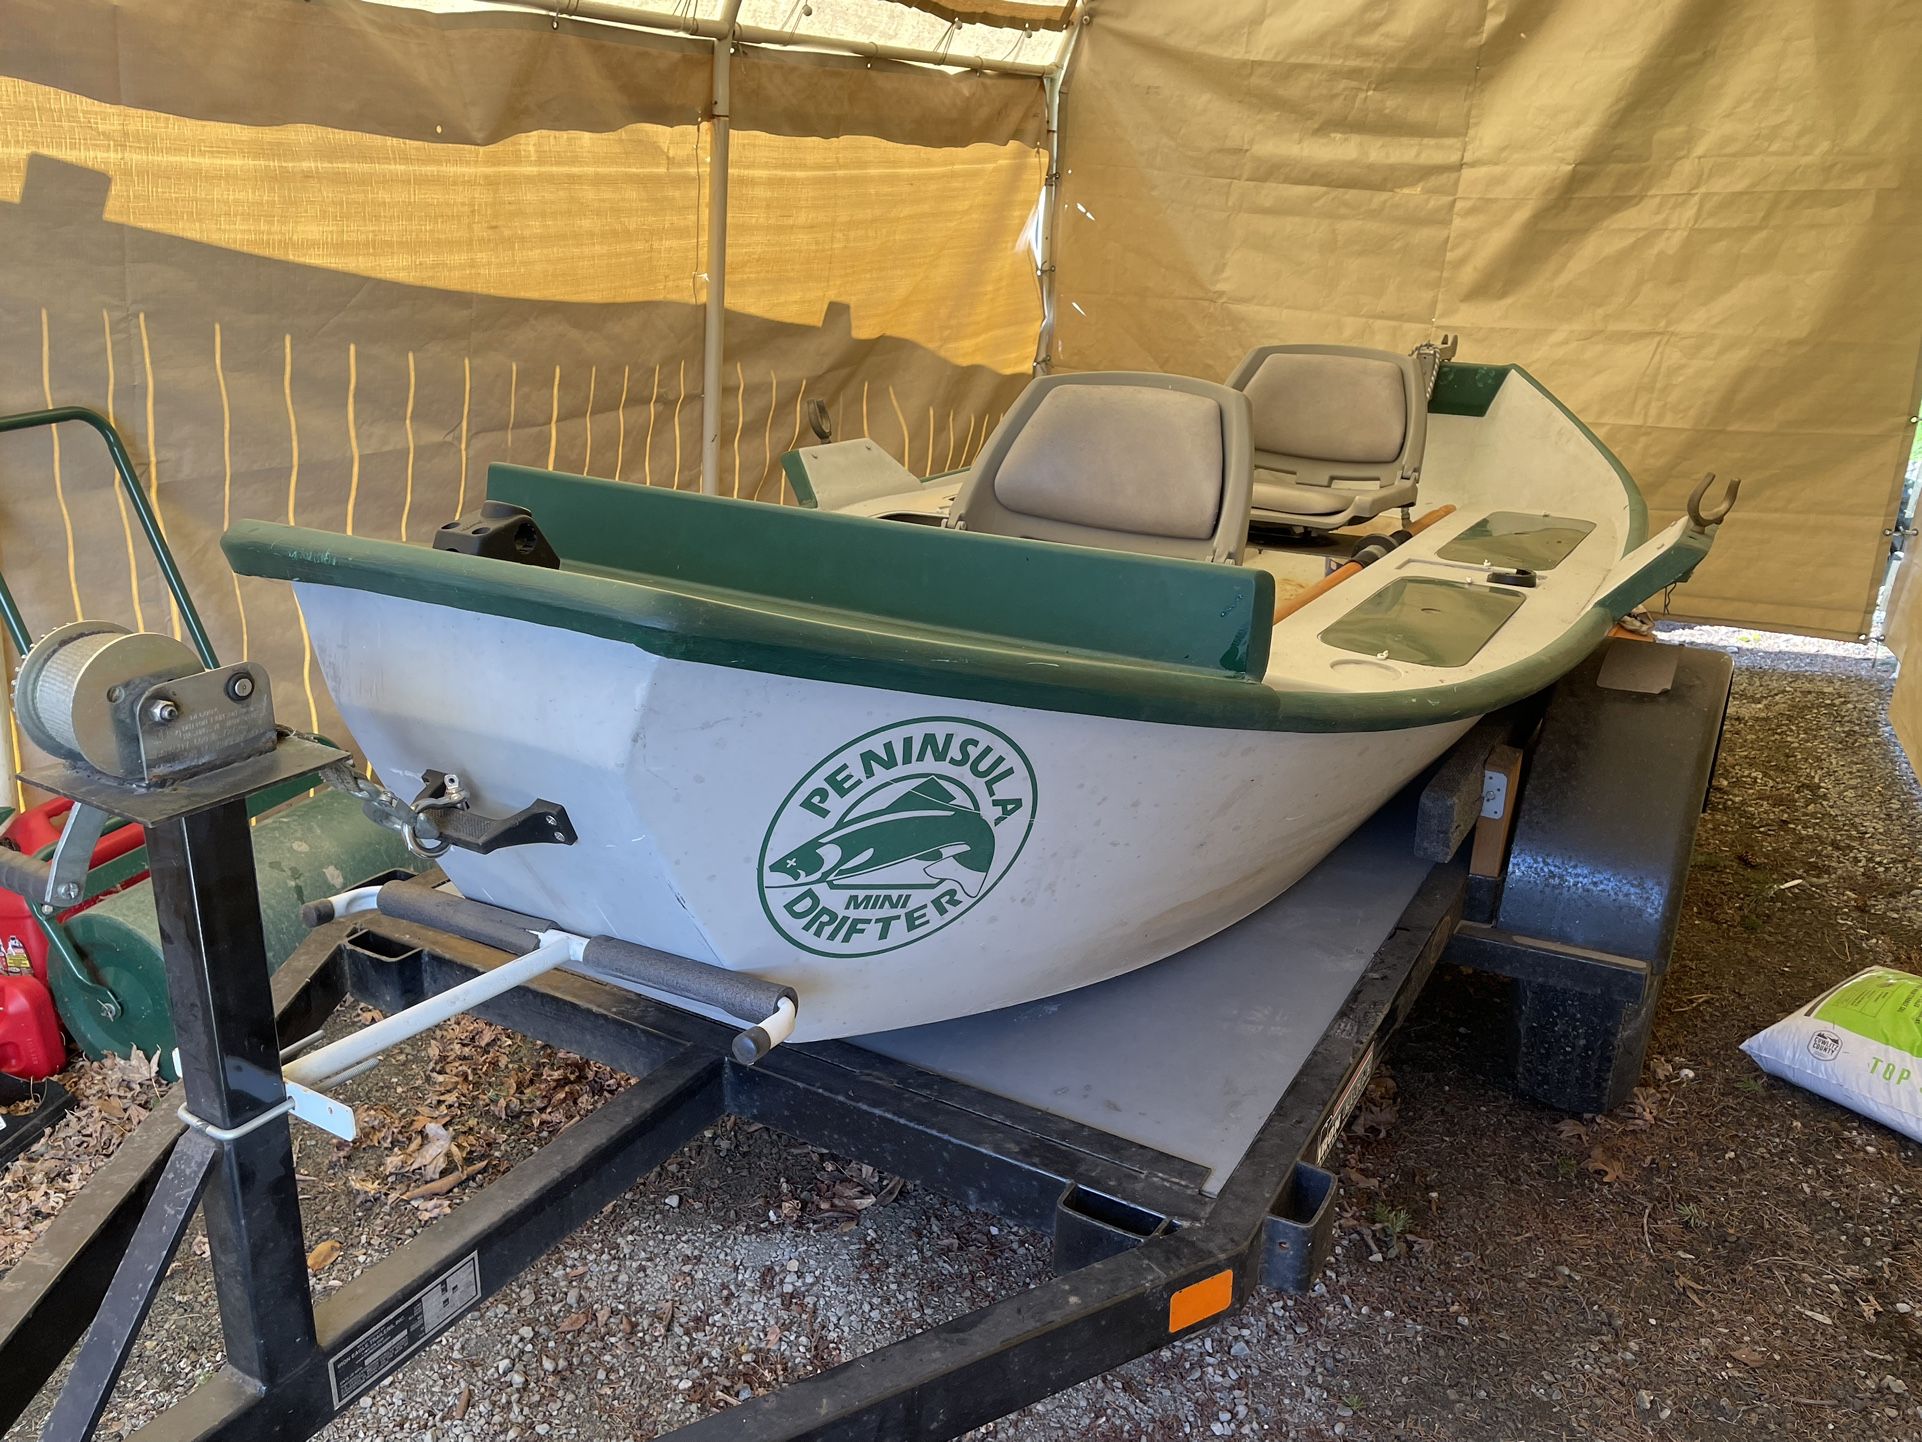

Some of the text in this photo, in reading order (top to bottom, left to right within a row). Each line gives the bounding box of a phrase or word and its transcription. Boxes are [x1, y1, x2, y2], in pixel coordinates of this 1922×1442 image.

[799, 733, 1023, 827] PENINSULA
[783, 888, 963, 943] DRIFTER
[844, 894, 912, 910] MINI
[1812, 1042, 1835, 1056] COUNTY
[1870, 1057, 1911, 1085] TOP
